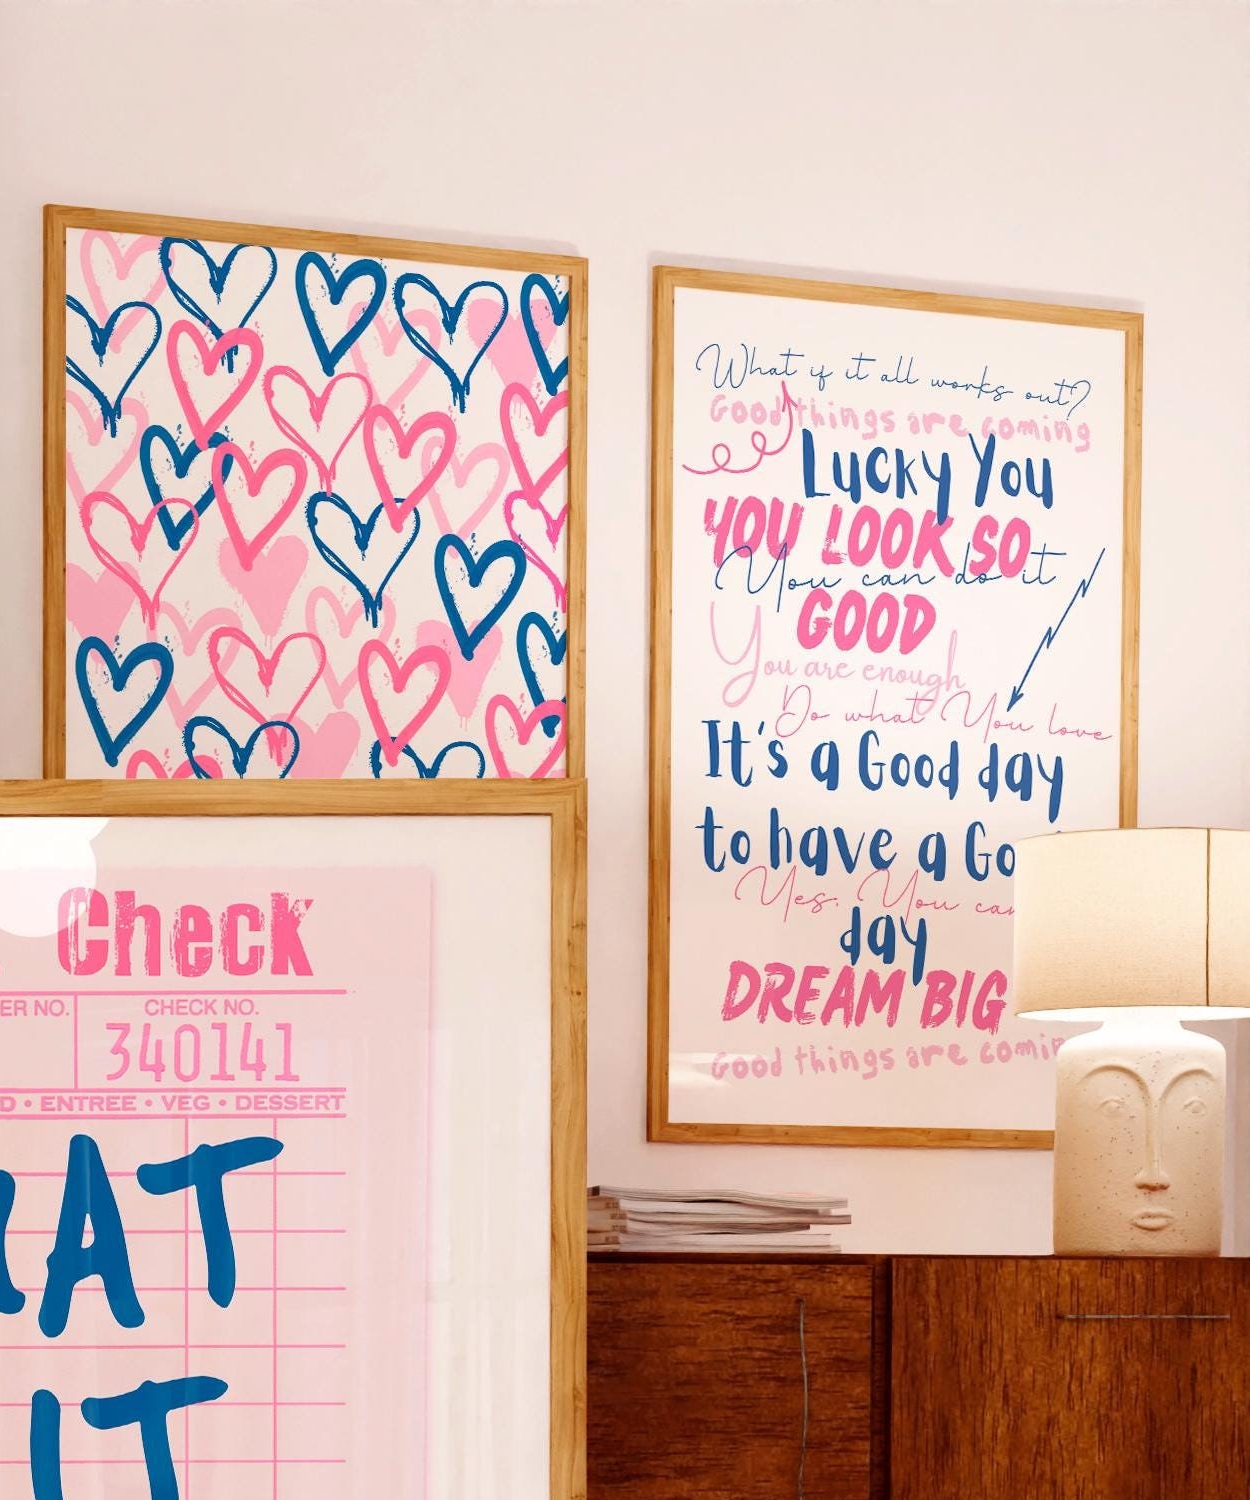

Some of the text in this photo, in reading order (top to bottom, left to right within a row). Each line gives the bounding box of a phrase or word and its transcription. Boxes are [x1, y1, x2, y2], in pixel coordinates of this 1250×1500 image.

[696, 343, 1092, 420] What if it all works out?
[709, 394, 1092, 452] Good things are coming
[968, 433, 1053, 509] You
[704, 496, 1031, 578] YOU LOOK SO
[714, 542, 1067, 612] You can do it
[796, 588, 937, 655] GOOD
[709, 601, 966, 715] You are enough
[775, 684, 1112, 744] Do what You love
[702, 720, 1064, 823] It's a Good day
[695, 806, 1016, 882] to have a Go
[857, 868, 960, 923] You
[57, 887, 315, 978] Check
[840, 905, 928, 986] day
[34, 999, 70, 1017] NO.
[144, 998, 260, 1016] CHECK NO.
[721, 960, 1008, 1035] DREAM BIG
[106, 1022, 300, 1082] 340141
[711, 1033, 1065, 1080] Good things are comin
[40, 1095, 137, 1112] ENTREE
[161, 1095, 210, 1112] VEG
[235, 1094, 345, 1111] DESSERT
